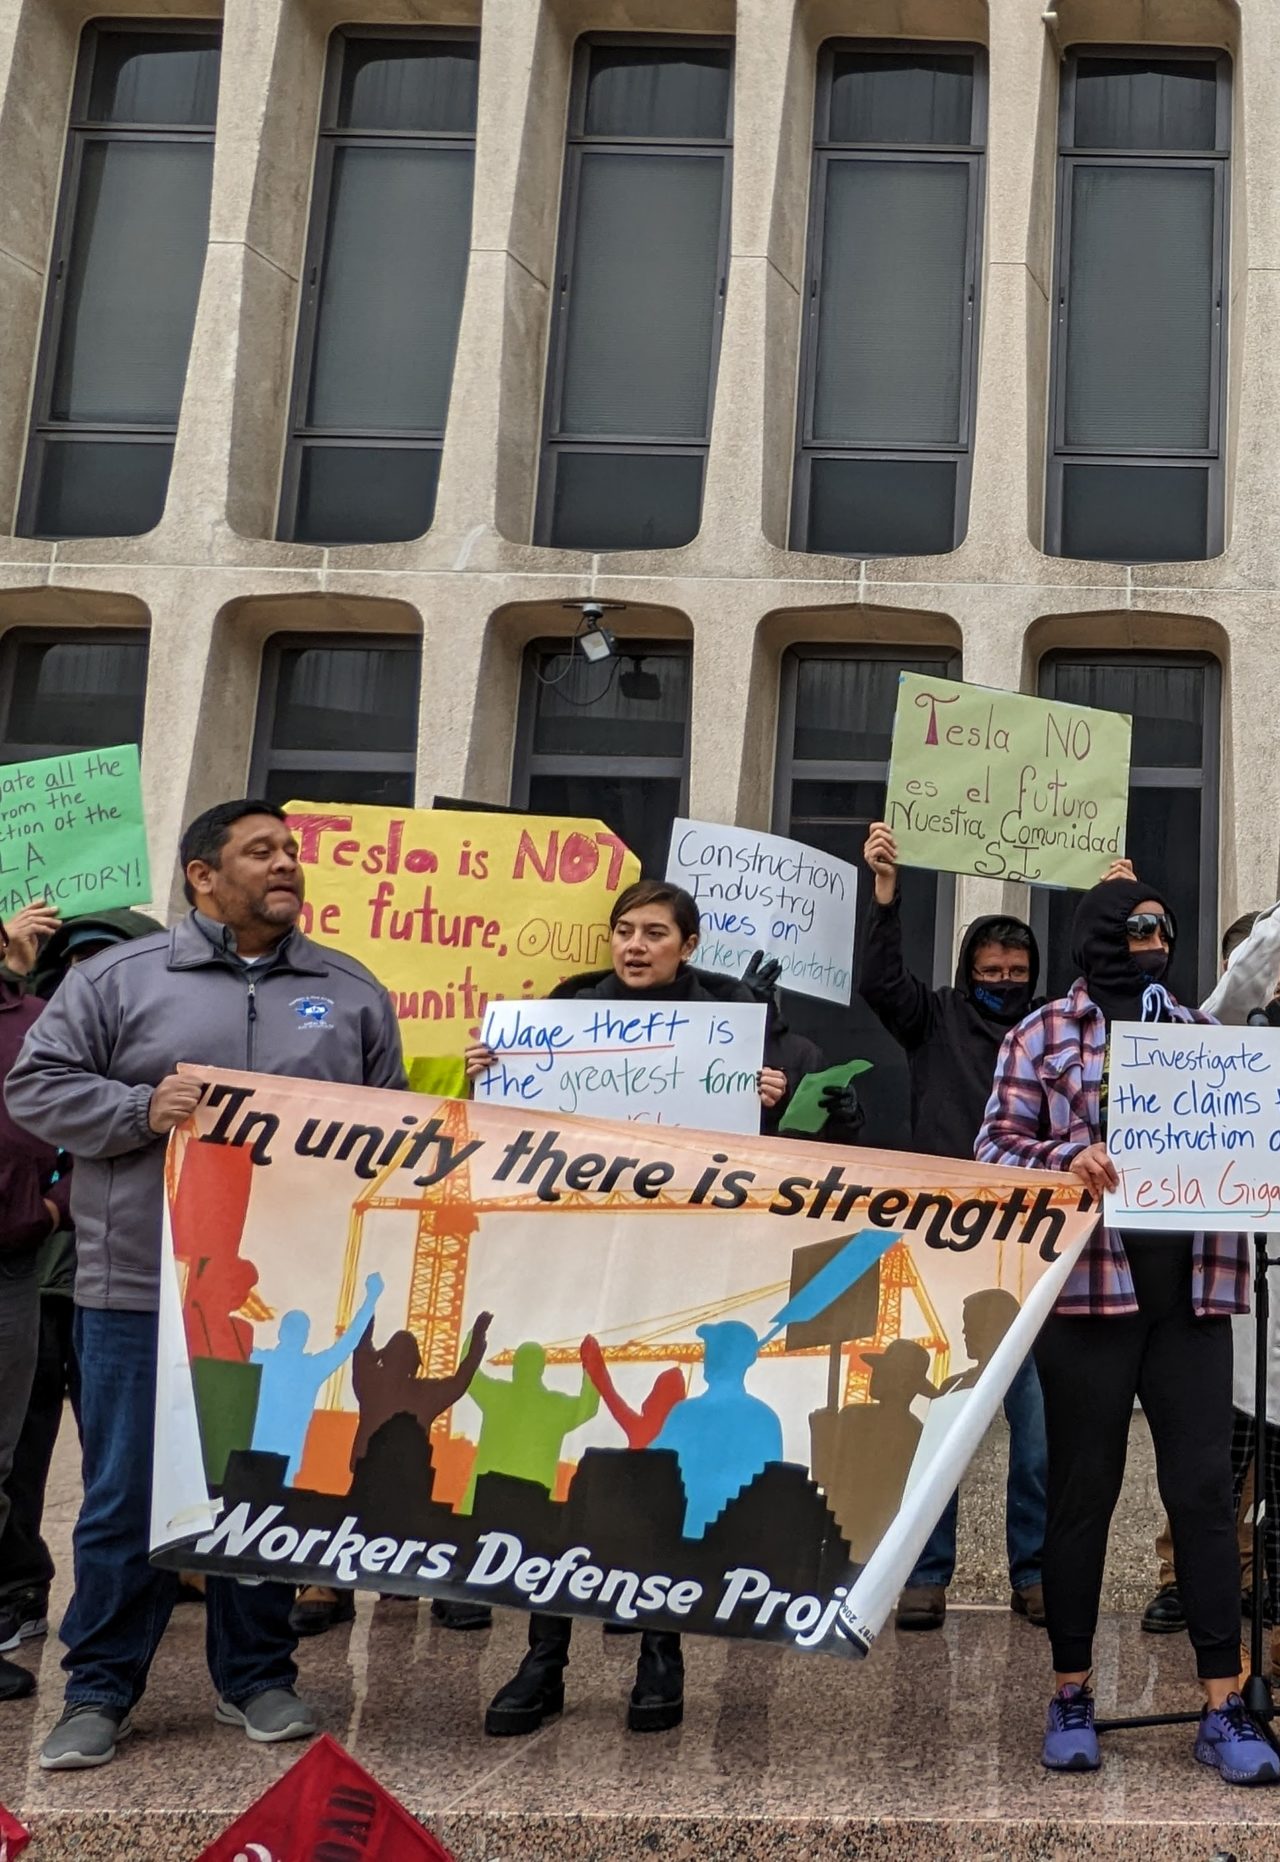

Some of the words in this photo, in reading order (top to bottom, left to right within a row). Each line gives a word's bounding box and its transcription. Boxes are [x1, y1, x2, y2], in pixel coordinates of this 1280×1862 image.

[915, 693, 1010, 752] Tesla
[1045, 712, 1091, 760] NO
[0, 769, 35, 801] ate
[45, 760, 76, 790] all
[84, 754, 124, 779] the
[906, 780, 938, 798] es
[967, 765, 990, 804] el
[1018, 765, 1098, 819] futuro
[0, 802, 36, 821] rom
[47, 792, 86, 809] the
[55, 811, 77, 830] of
[85, 803, 122, 825] the
[891, 801, 986, 839] Nuestra
[1000, 810, 1120, 853] Comunidad
[283, 813, 438, 875] Tesla
[458, 840, 489, 880] is
[512, 828, 630, 892] NOT
[678, 830, 845, 900] Construction
[368, 881, 508, 958] future,
[517, 918, 611, 965] our
[689, 873, 816, 932] Industry
[771, 920, 798, 945] on
[762, 950, 850, 990] eploitation
[485, 1010, 575, 1071] Wage
[583, 1009, 689, 1043] theft
[708, 1015, 734, 1045] is
[1121, 1034, 1271, 1088] Investigate
[480, 1064, 543, 1099] the
[559, 1057, 686, 1113] greatest
[699, 1058, 757, 1093] form
[1114, 1083, 1161, 1115] the
[1173, 1080, 1260, 1116] claims
[294, 1115, 486, 1187] unity
[493, 1130, 675, 1201] there
[689, 1153, 757, 1209] is
[1109, 1121, 1255, 1155] construction
[1116, 1164, 1205, 1209] Tesla
[195, 1502, 459, 1582] Workers
[466, 1531, 703, 1620] Defense
[715, 1567, 848, 1647] Proj
